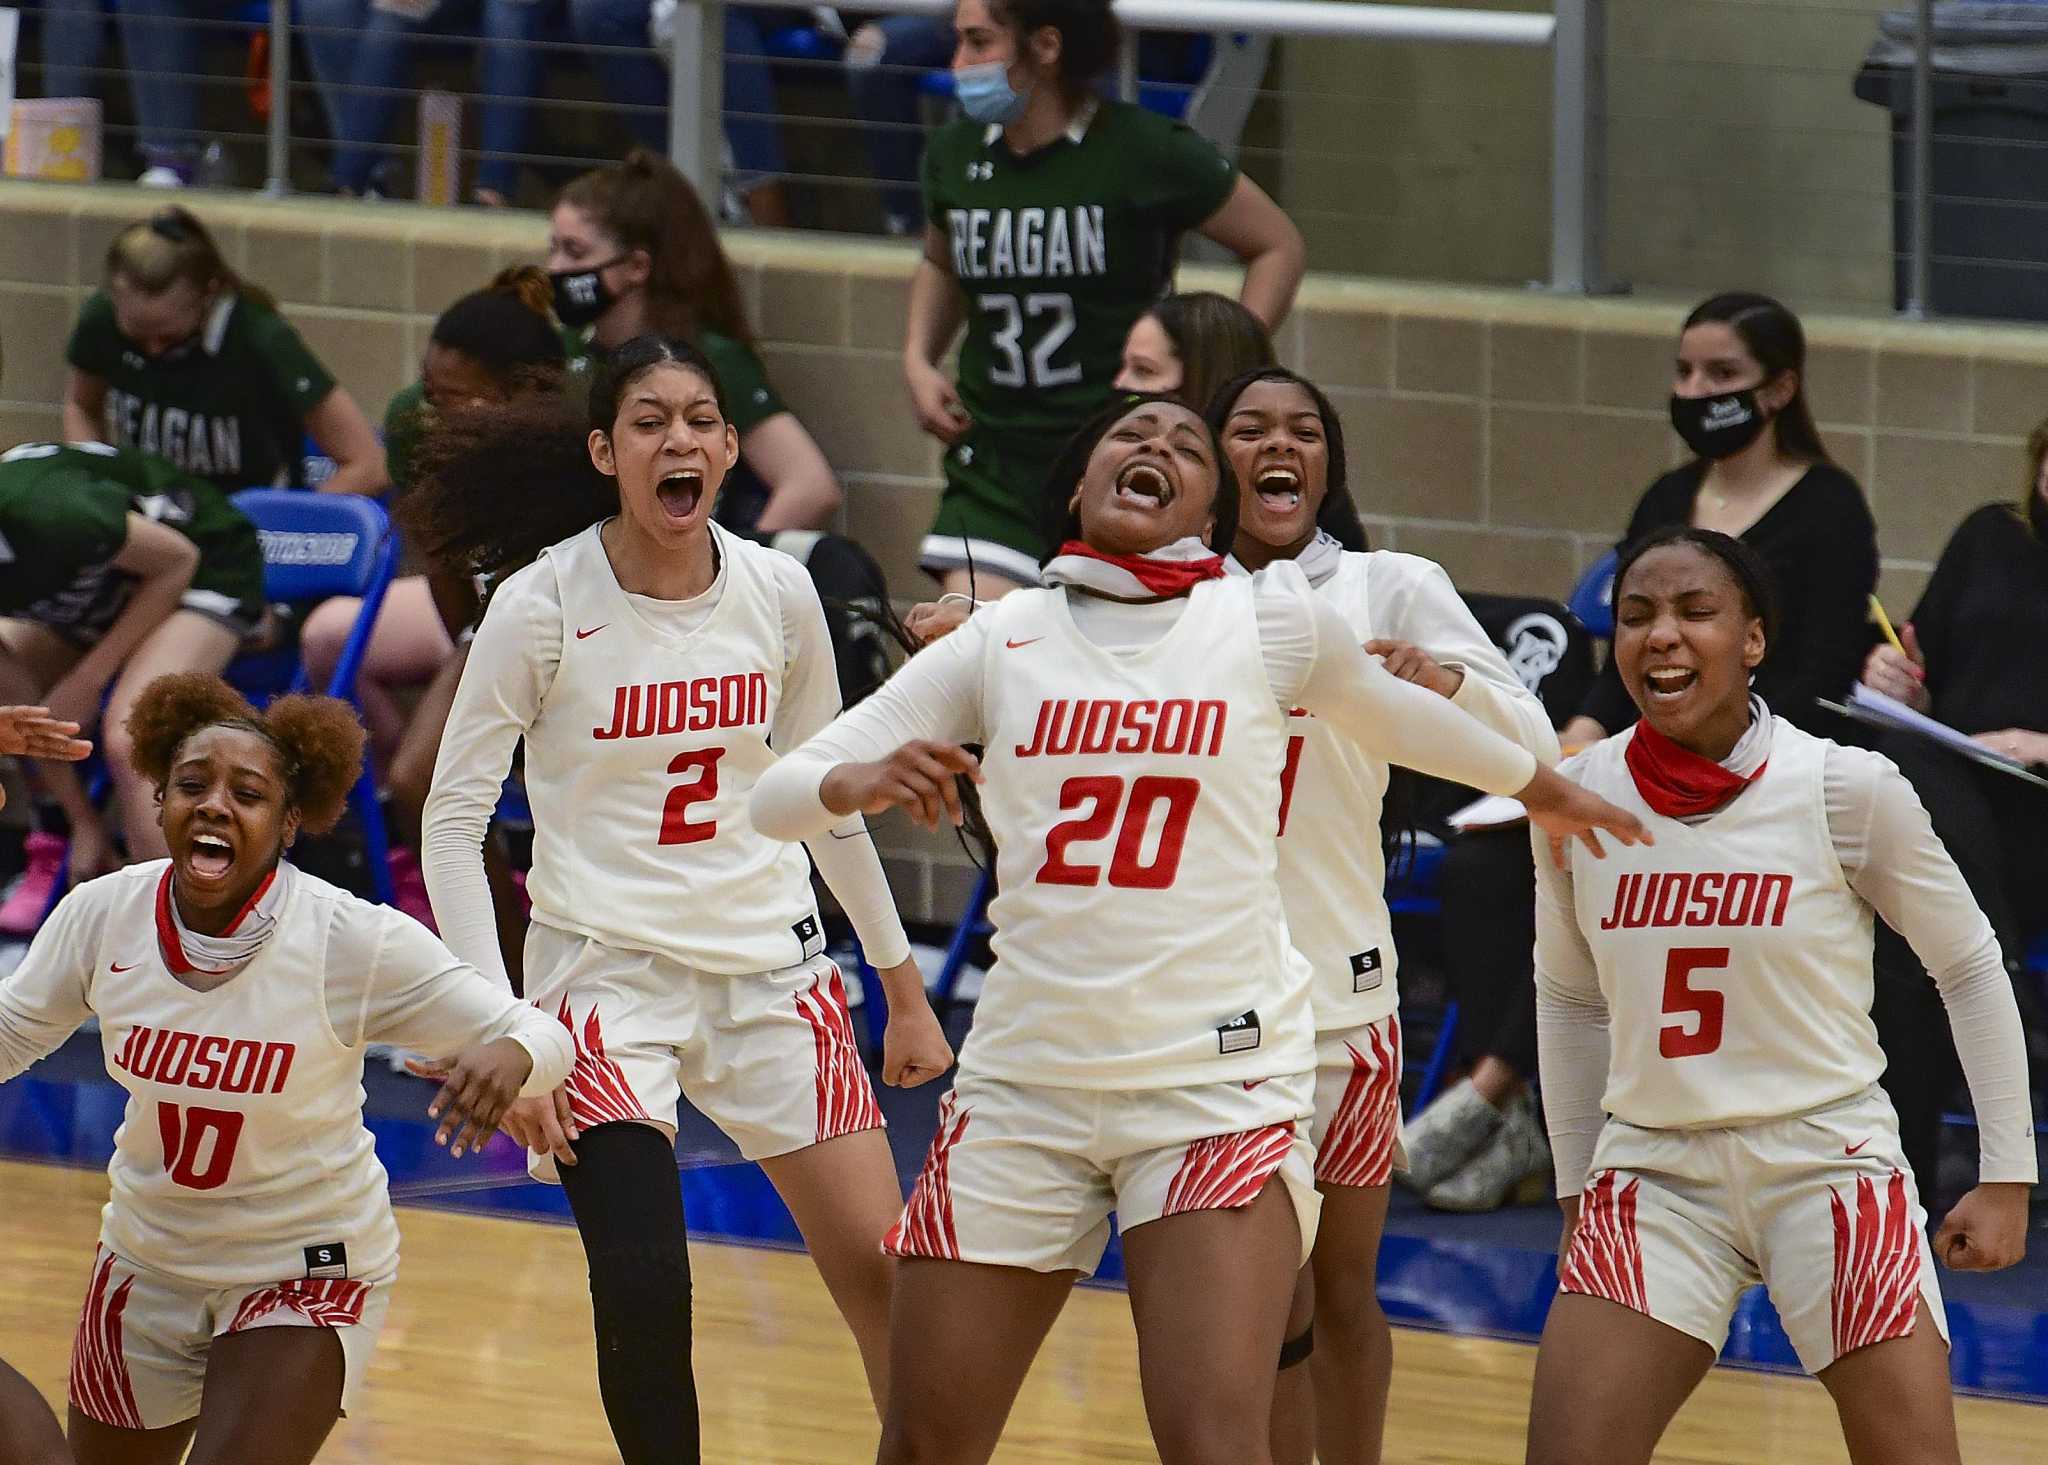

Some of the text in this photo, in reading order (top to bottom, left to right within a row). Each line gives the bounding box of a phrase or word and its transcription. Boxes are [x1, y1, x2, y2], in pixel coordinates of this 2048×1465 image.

[948, 206, 1107, 277] REAGAN
[977, 292, 1083, 388] 32
[592, 672, 768, 740] JUDSON
[1014, 699, 1228, 757] JUDSON
[657, 746, 727, 846] 2
[1035, 774, 1201, 889] 20
[802, 922, 812, 935] S
[1600, 873, 1793, 930] JUDSON
[1362, 955, 1372, 969] S
[1658, 947, 1730, 1059] 5
[113, 1024, 296, 1094] JUDSON
[157, 1101, 245, 1191] 10
[318, 1249, 332, 1263] S
